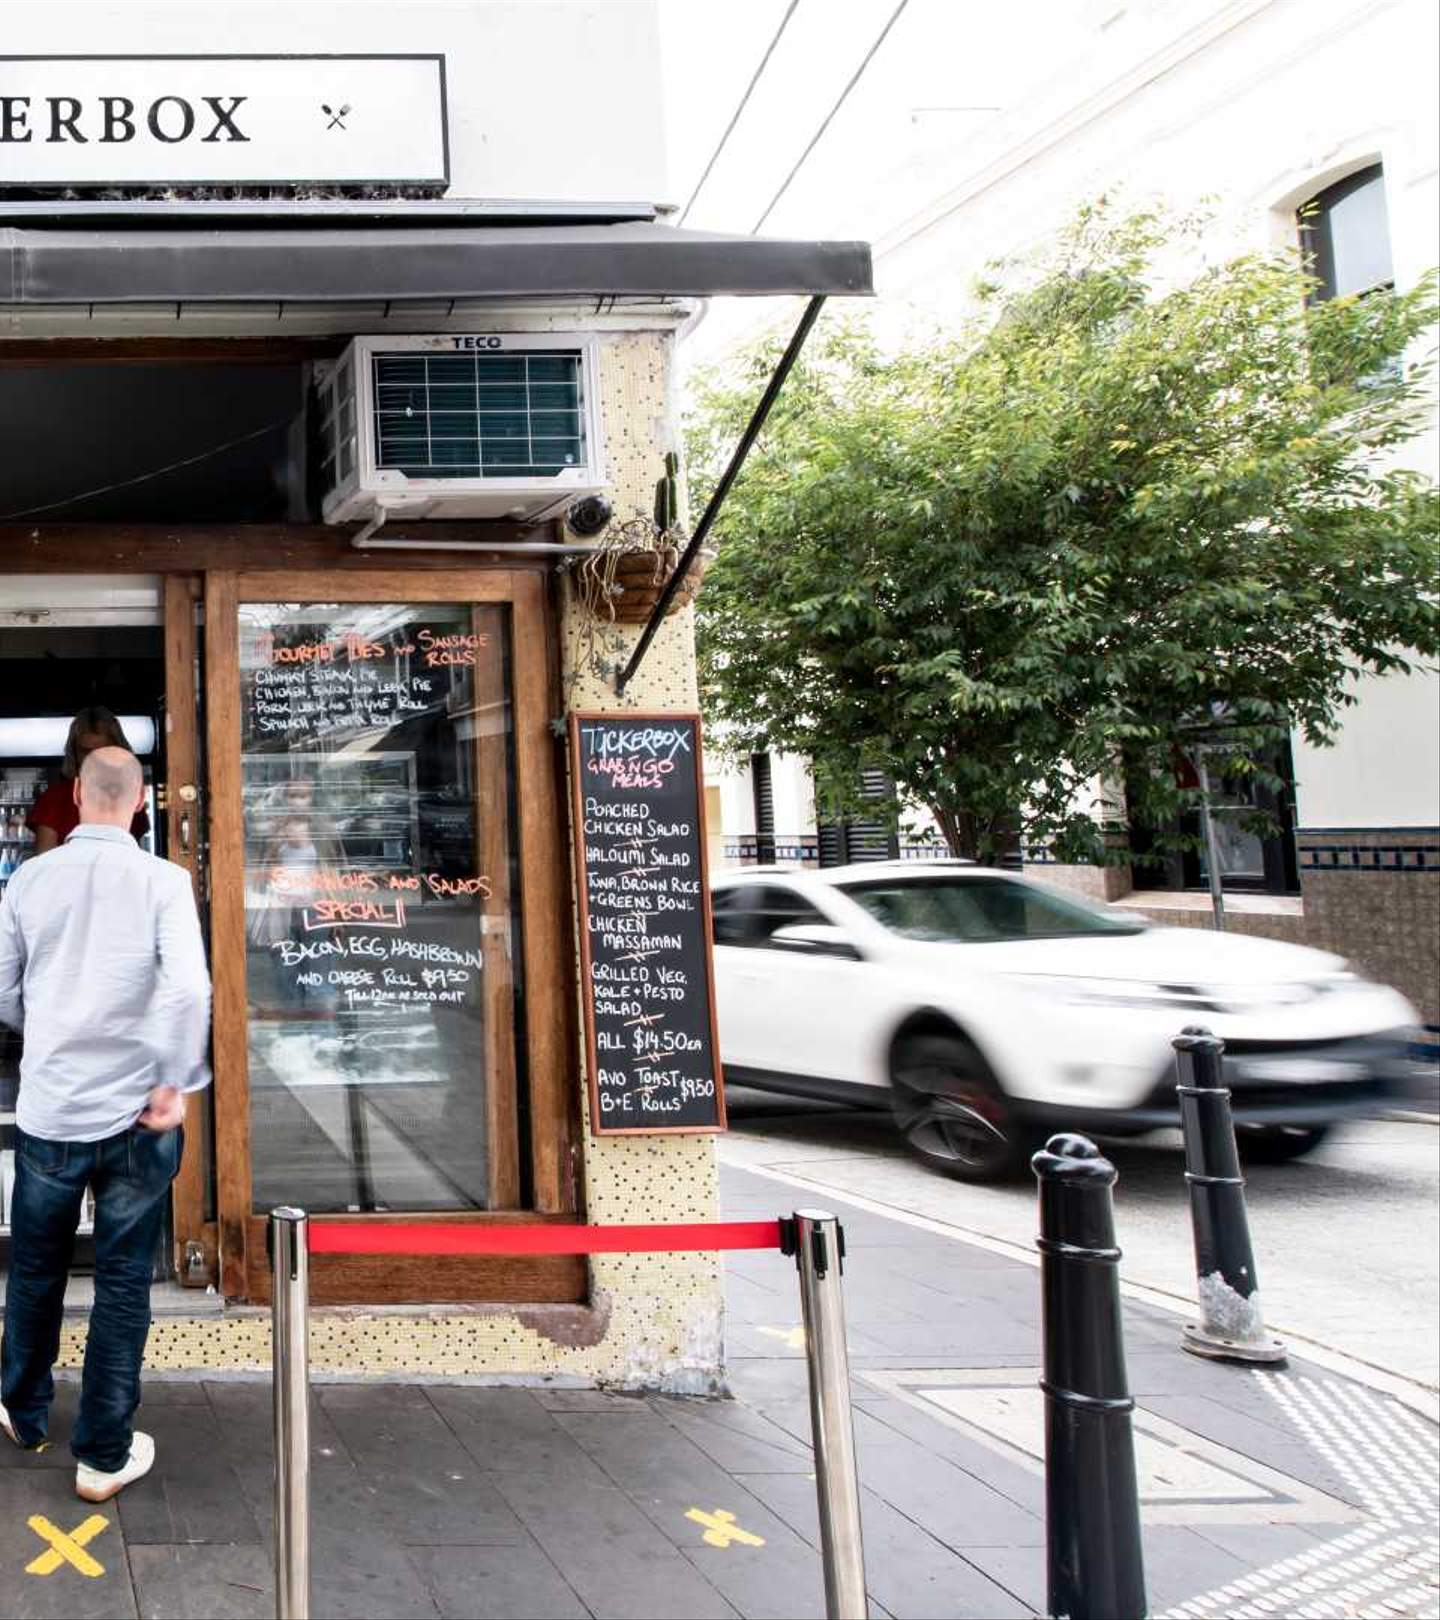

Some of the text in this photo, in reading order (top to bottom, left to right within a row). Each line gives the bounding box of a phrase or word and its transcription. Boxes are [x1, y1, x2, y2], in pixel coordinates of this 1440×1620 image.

[451, 336, 503, 349] TECO
[418, 630, 490, 650] SAUSAGE
[425, 650, 476, 667] ROLLS
[412, 676, 432, 692] PIE
[399, 697, 428, 711] ROLL
[581, 727, 691, 760] TUCKERBOX
[587, 758, 626, 775] GRAB
[643, 758, 674, 774] GO
[611, 773, 663, 788] MEALS
[585, 797, 650, 819] POACHED
[584, 819, 690, 837] CHICKEN SALAD
[586, 846, 690, 866] HALOUMI SALAD
[389, 876, 420, 890] AND
[429, 873, 493, 900] SALADS
[671, 877, 700, 894] RICE
[597, 893, 653, 910] GREENS
[657, 894, 695, 911] BOWL
[587, 914, 647, 933] CHICKEN
[603, 934, 682, 950] MASSAMAN
[391, 938, 483, 969] HASHBROWN
[296, 973, 323, 985] AND
[382, 968, 418, 986] ROLL
[591, 962, 649, 982] GRILLED
[439, 991, 466, 1002] OUT
[594, 984, 630, 998] KALE
[643, 984, 685, 1000] PESTO
[595, 1001, 642, 1016] SALAD
[597, 1032, 626, 1049] ALL
[597, 1066, 680, 1088] AVO TOAST
[642, 1094, 681, 1111] ROLLS
